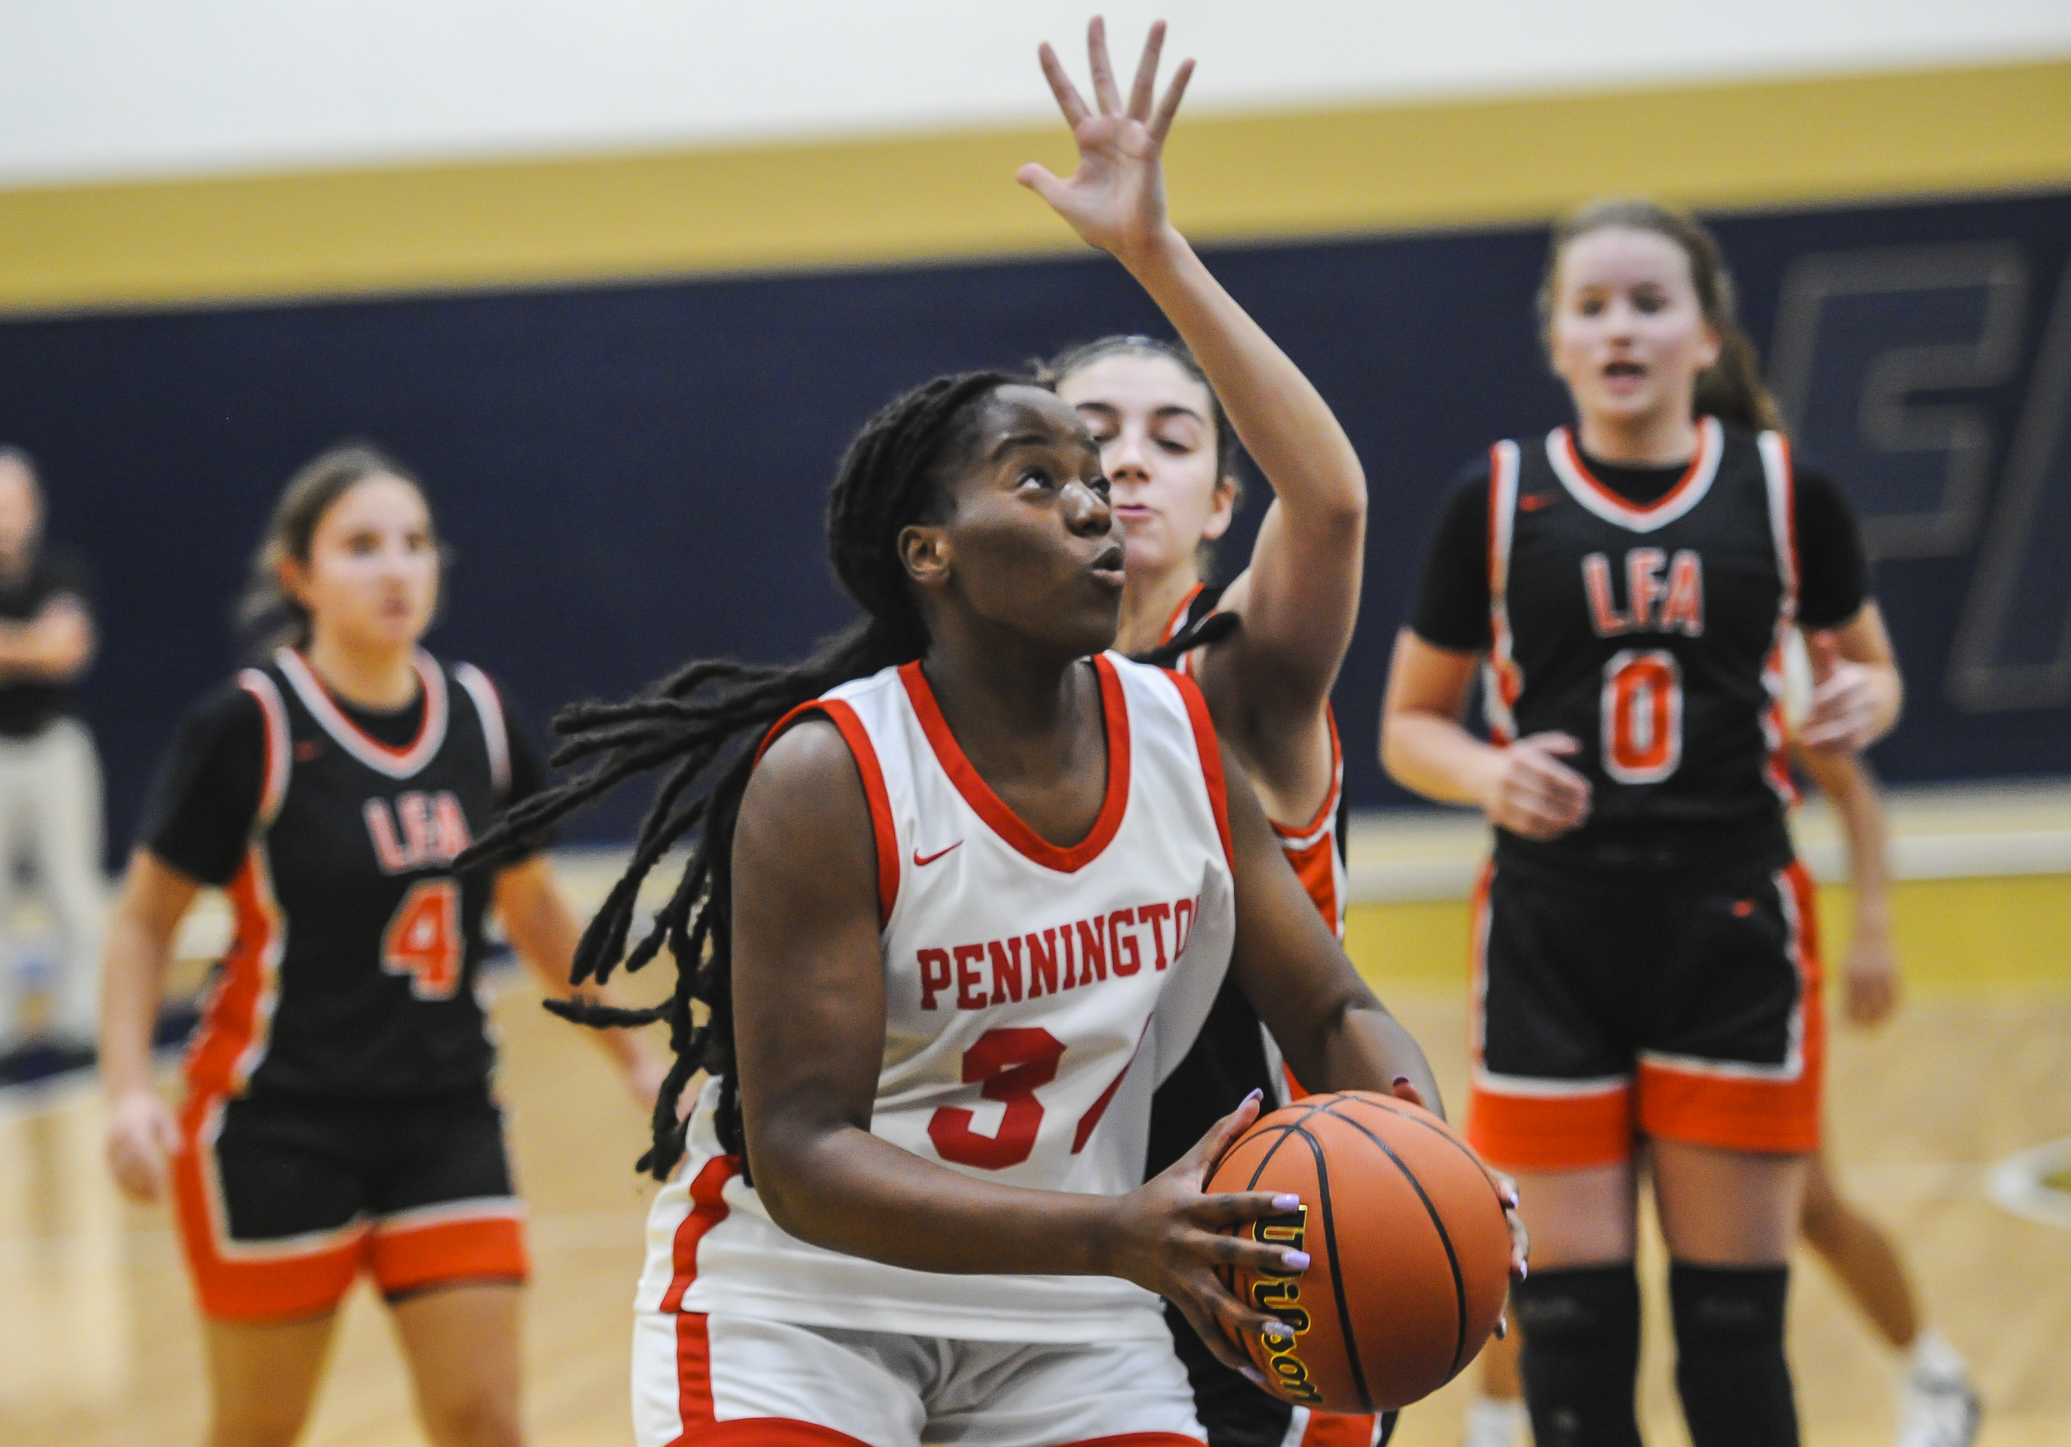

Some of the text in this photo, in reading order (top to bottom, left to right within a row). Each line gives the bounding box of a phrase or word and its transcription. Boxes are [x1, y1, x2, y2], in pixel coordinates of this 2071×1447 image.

[1581, 547, 1705, 638] LFA
[1600, 649, 1684, 785] 0
[362, 790, 473, 876] LFA
[379, 876, 466, 1001] 4
[916, 894, 1201, 1012] PENNINGTO
